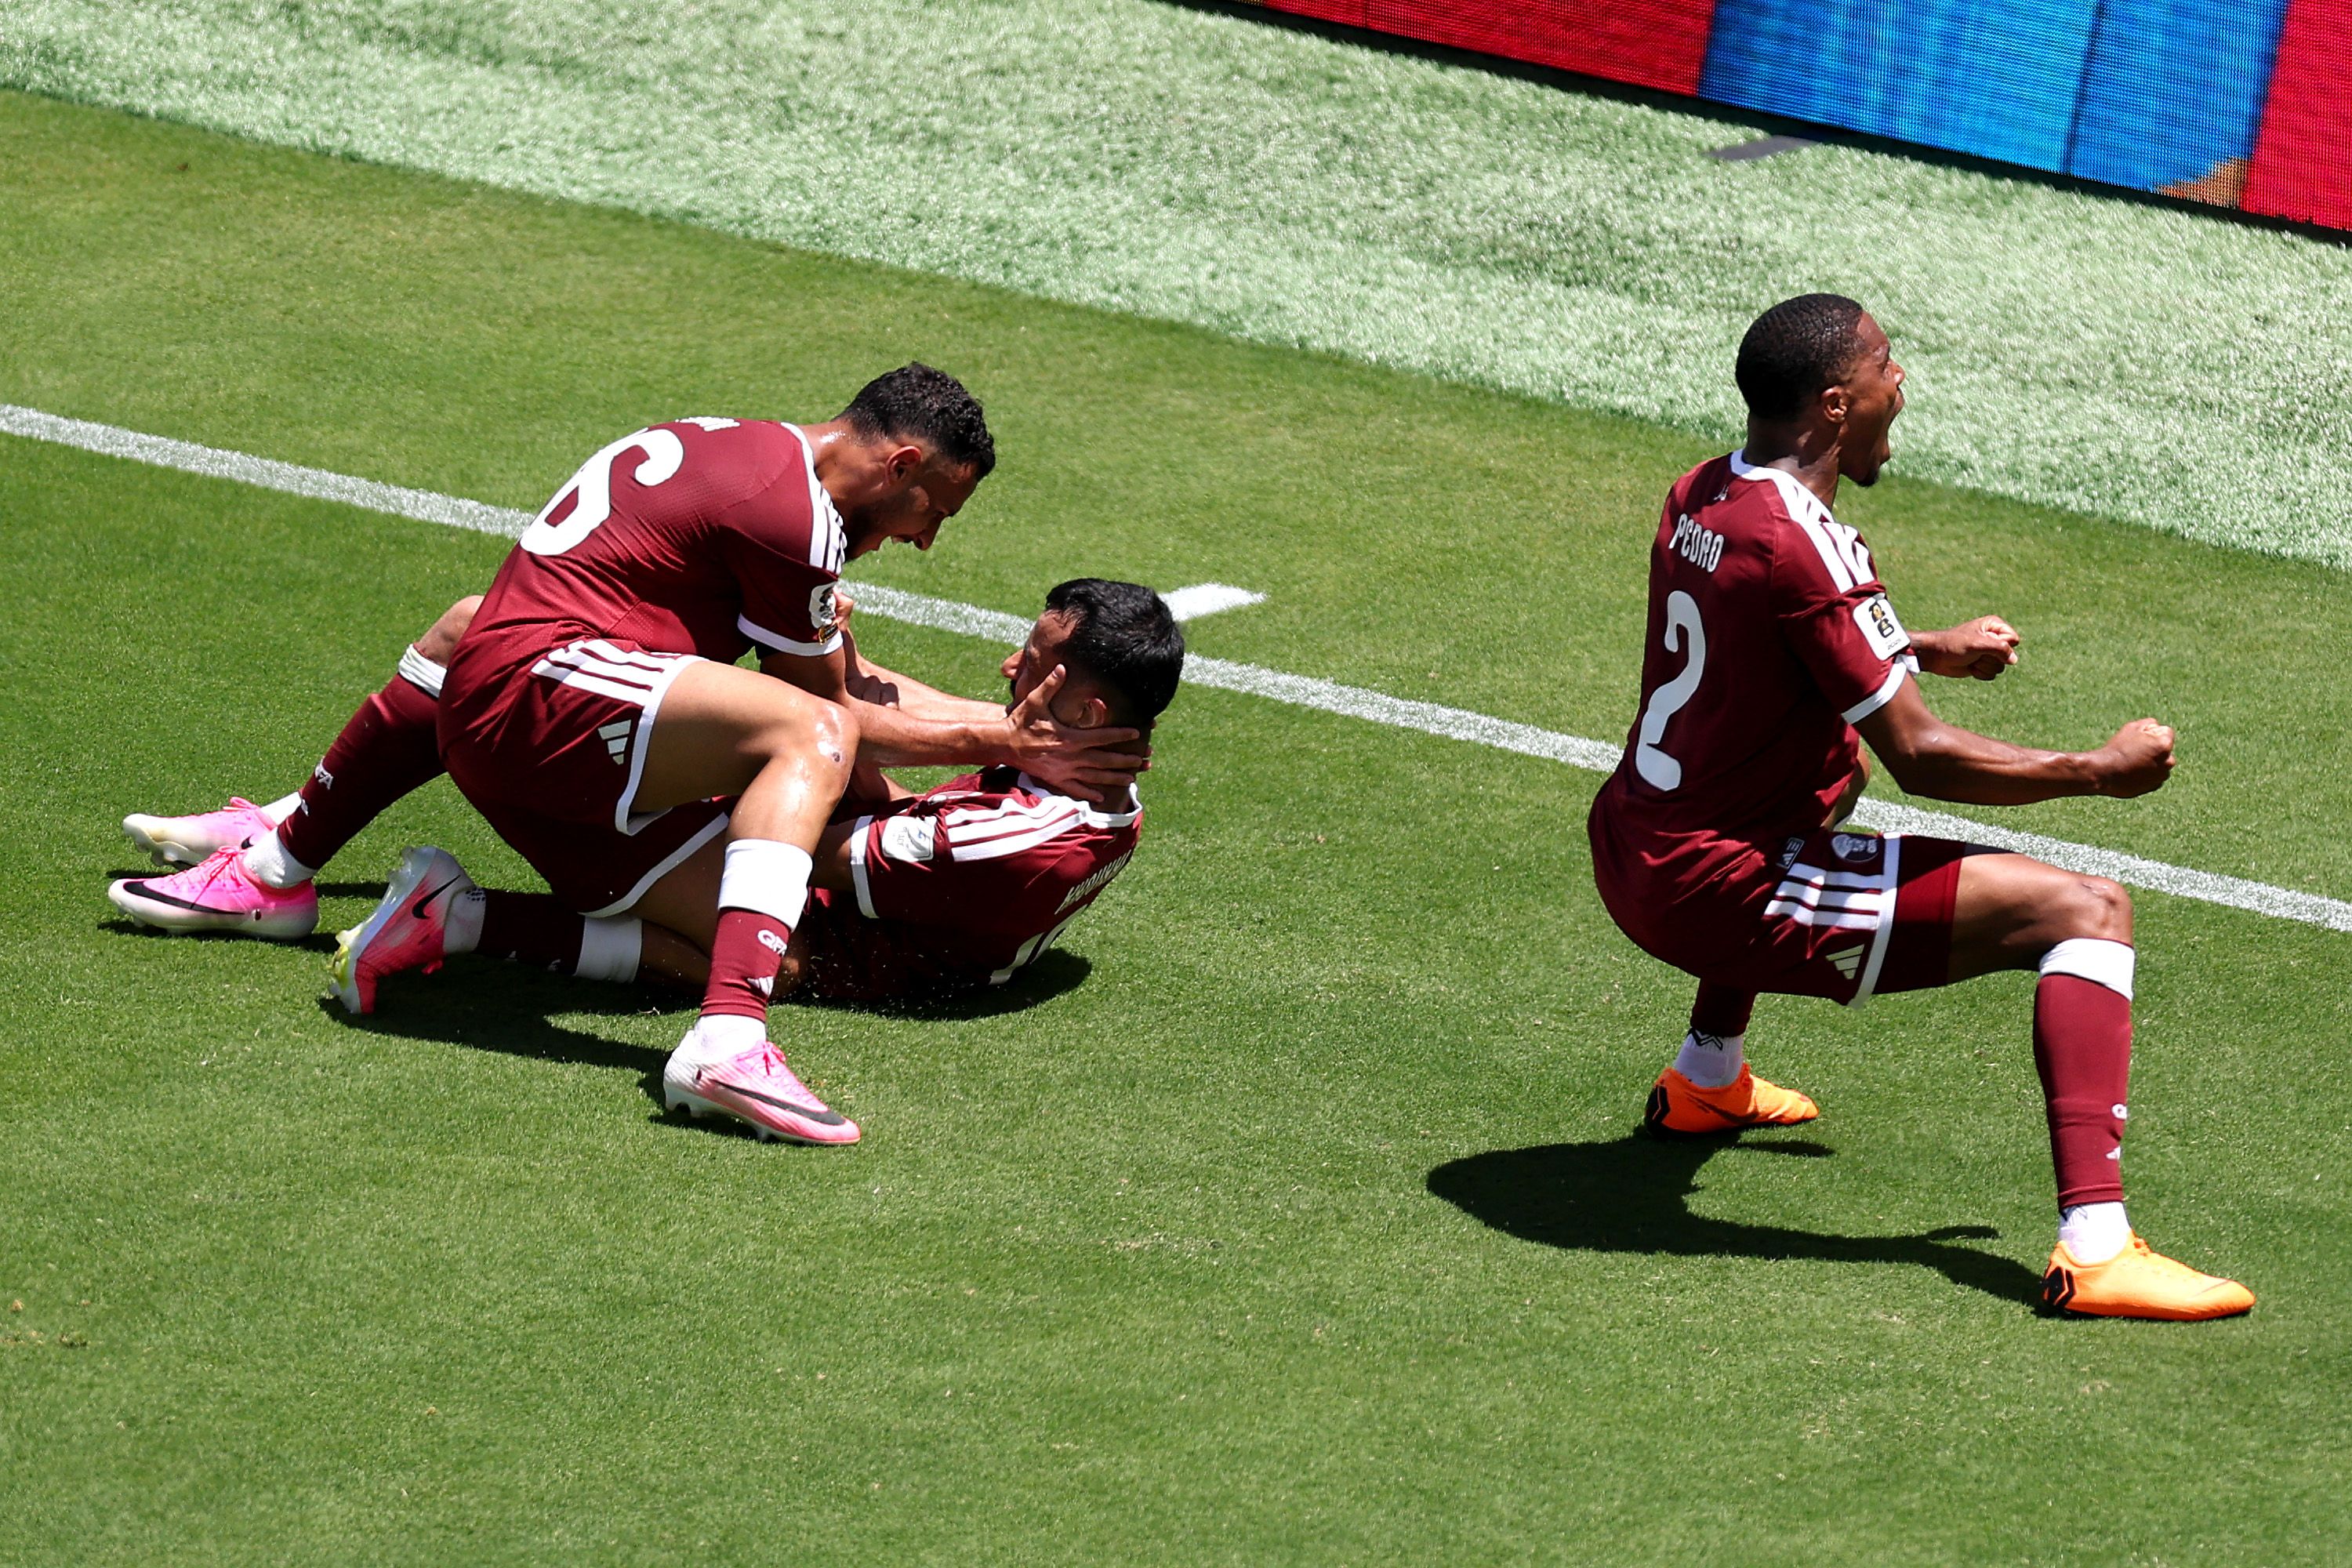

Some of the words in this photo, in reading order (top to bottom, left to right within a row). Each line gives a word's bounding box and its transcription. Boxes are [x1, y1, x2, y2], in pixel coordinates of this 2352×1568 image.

[1668, 513, 1724, 573] PEDRO
[1635, 590, 1706, 792] 2
[315, 756, 334, 789] FA
